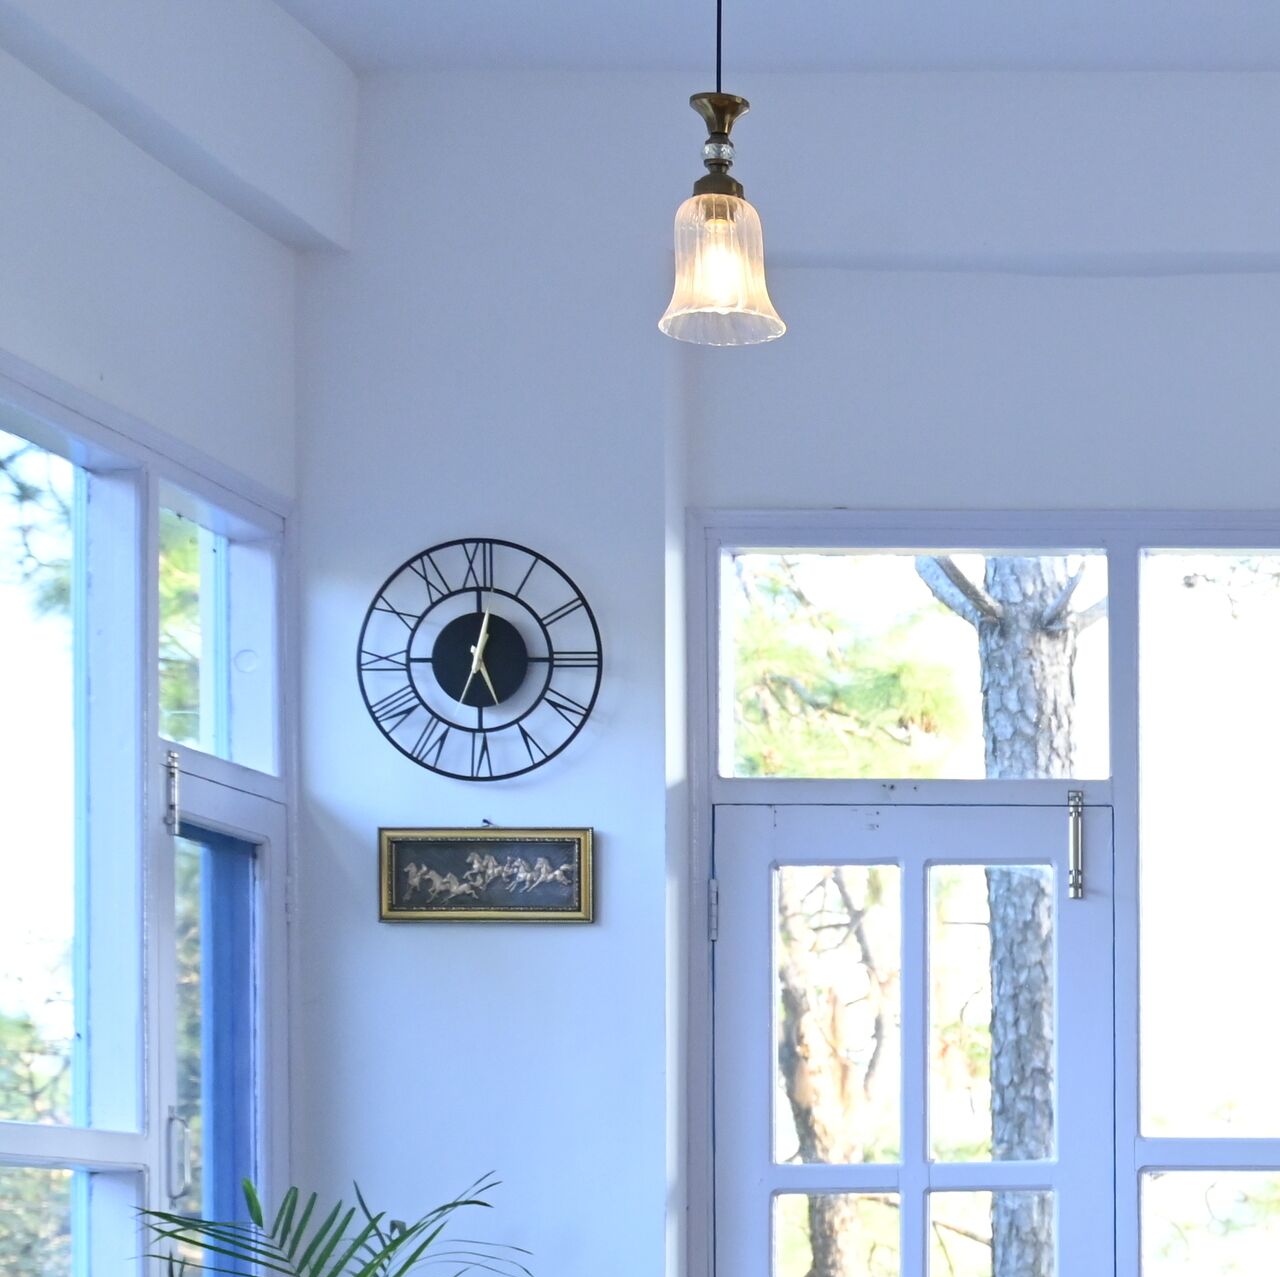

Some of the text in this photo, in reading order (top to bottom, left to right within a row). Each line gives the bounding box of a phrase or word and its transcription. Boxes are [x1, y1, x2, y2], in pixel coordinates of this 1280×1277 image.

[462, 542, 494, 589] XII
[515, 557, 538, 597] I
[541, 597, 585, 627] II
[552, 651, 599, 667] III
